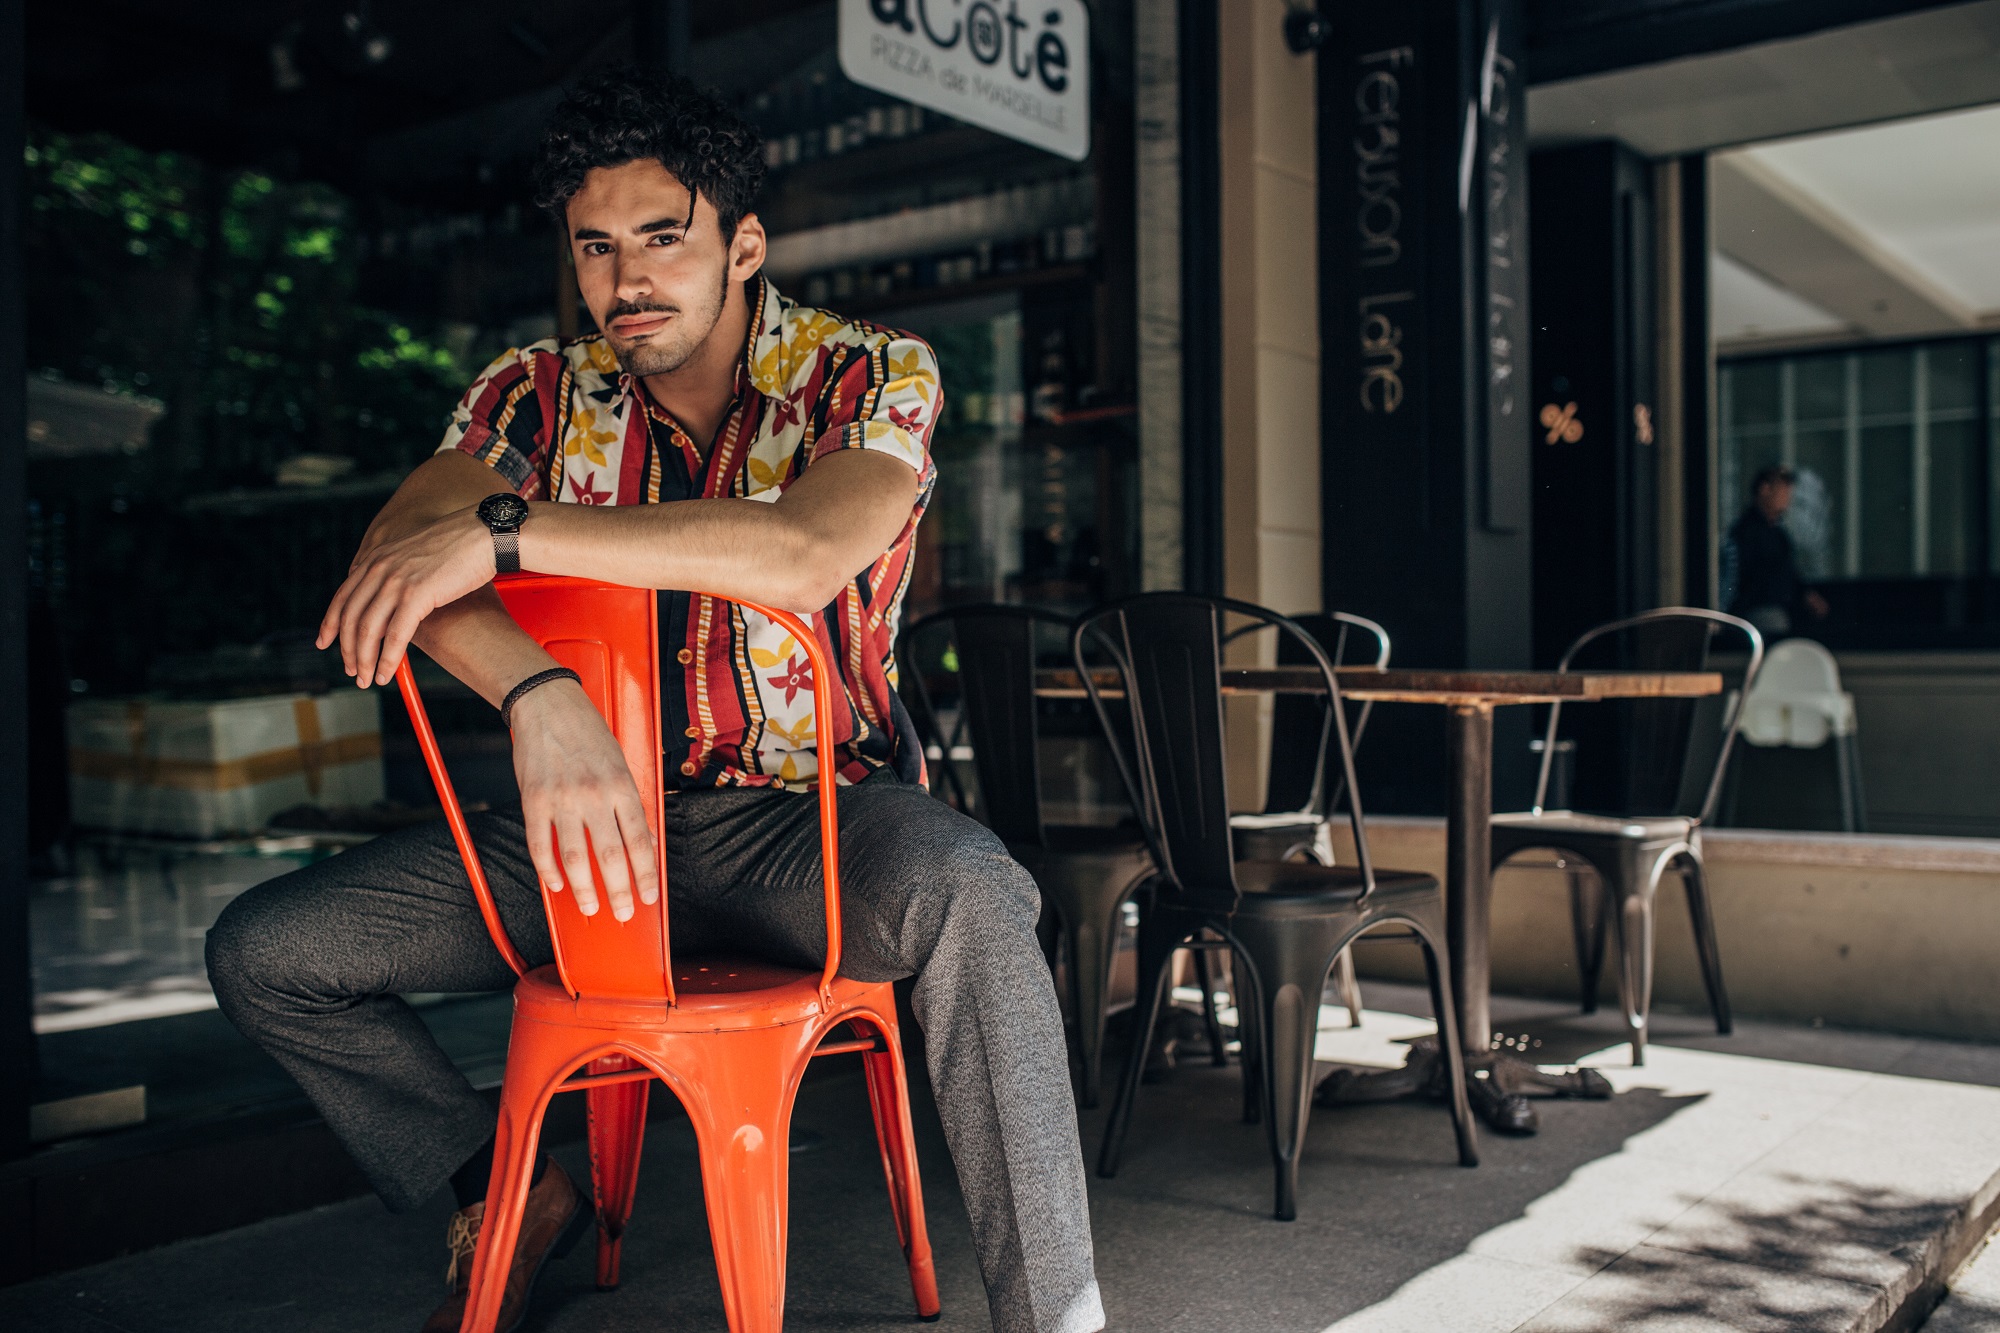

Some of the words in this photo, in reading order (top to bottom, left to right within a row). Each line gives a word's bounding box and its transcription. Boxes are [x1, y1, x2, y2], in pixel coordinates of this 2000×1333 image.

[871, 33, 936, 81] PIZZA
[938, 65, 969, 96] de
[1359, 291, 1415, 414] Lane
